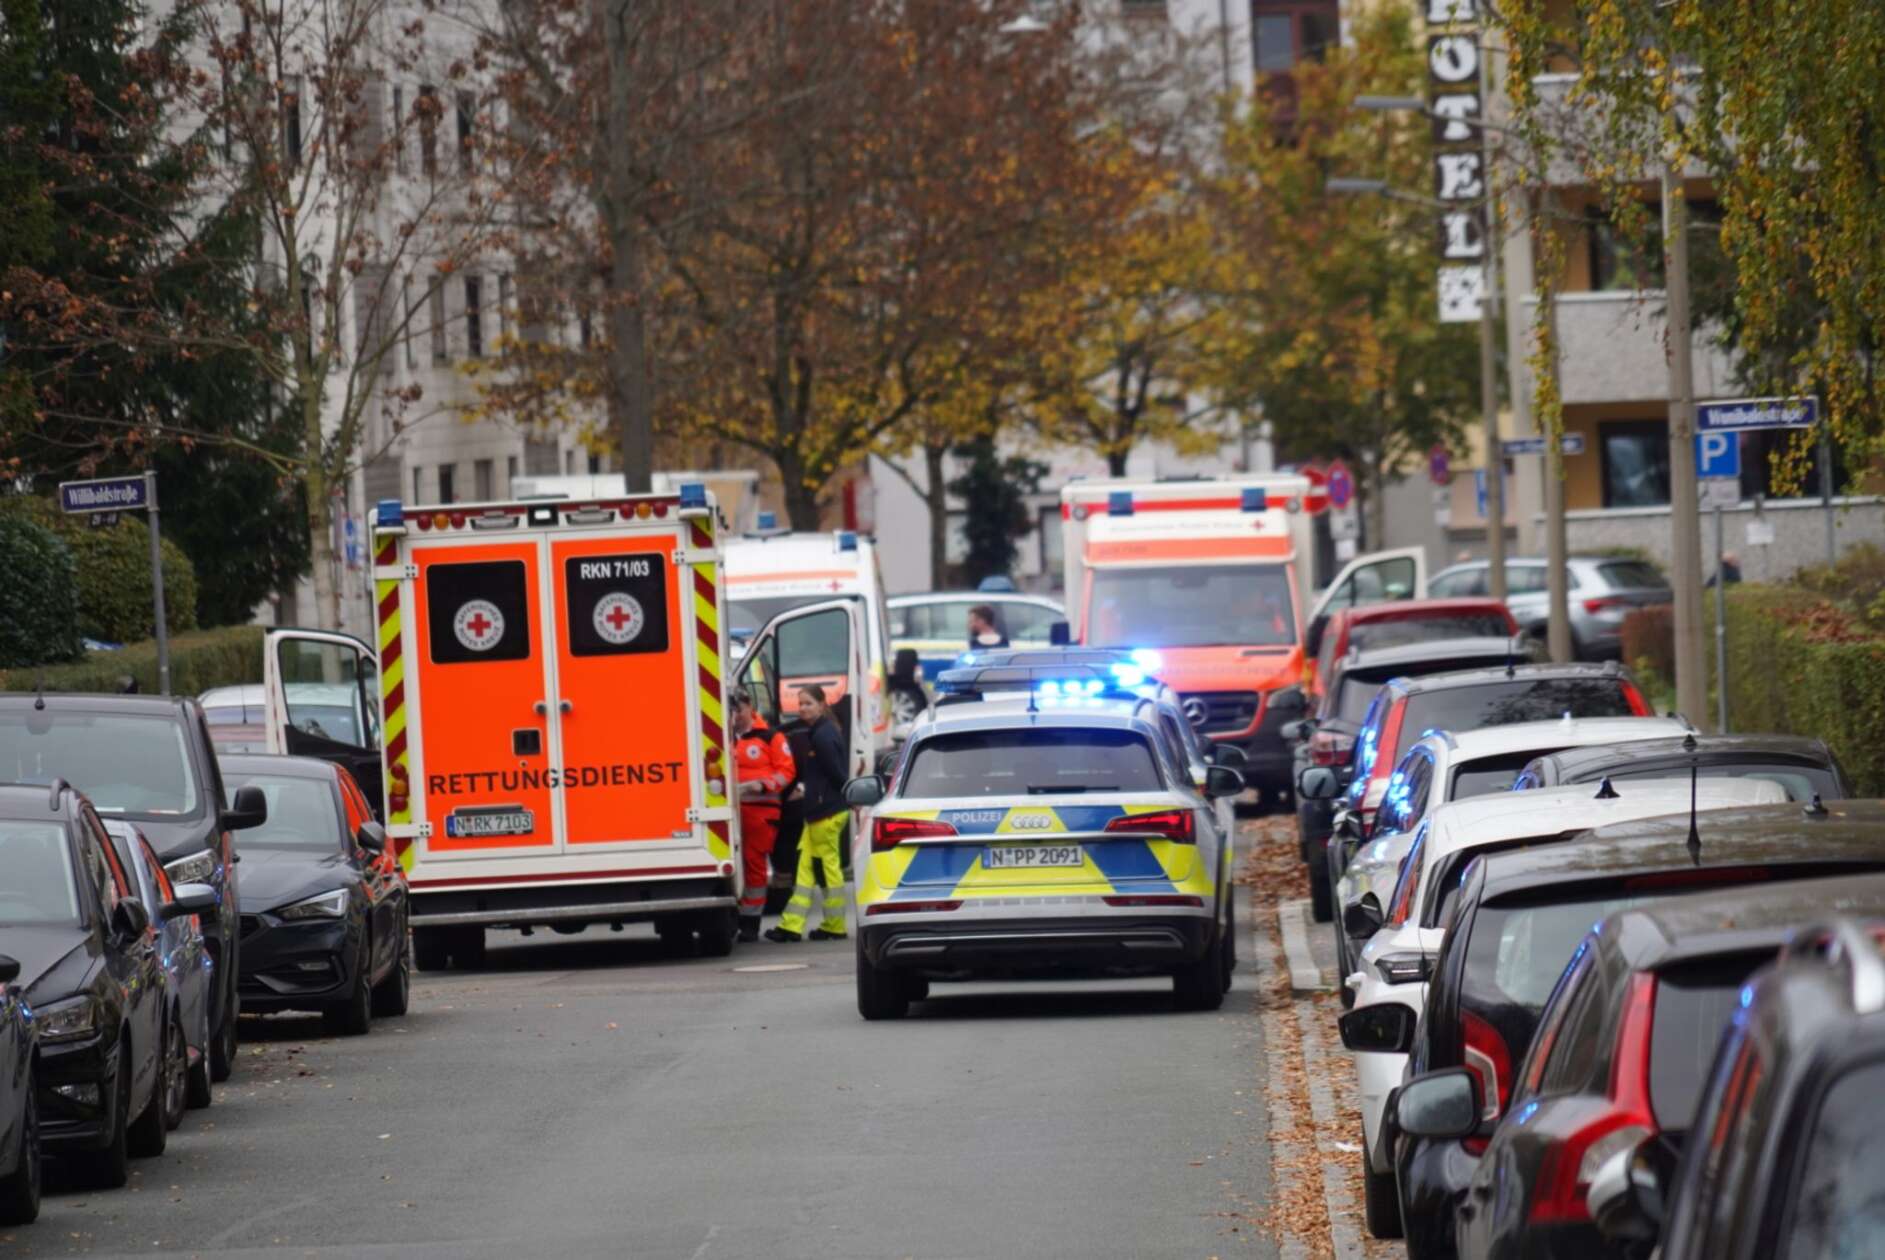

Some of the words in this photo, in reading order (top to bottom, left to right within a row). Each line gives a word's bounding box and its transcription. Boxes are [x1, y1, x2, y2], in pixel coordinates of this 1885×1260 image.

[1701, 433, 1728, 472] P
[68, 484, 139, 506] Willibaldstraße
[580, 563, 611, 579] RKN
[613, 560, 650, 577] 71/03
[428, 762, 683, 796] RETTUNGSDIENST
[455, 819, 466, 833] N
[474, 817, 493, 832] RK
[495, 814, 531, 831] 7103
[952, 812, 1002, 824] POLIZEI
[991, 851, 1003, 866] N
[1014, 849, 1036, 865] PP
[1039, 847, 1082, 864] 2091
